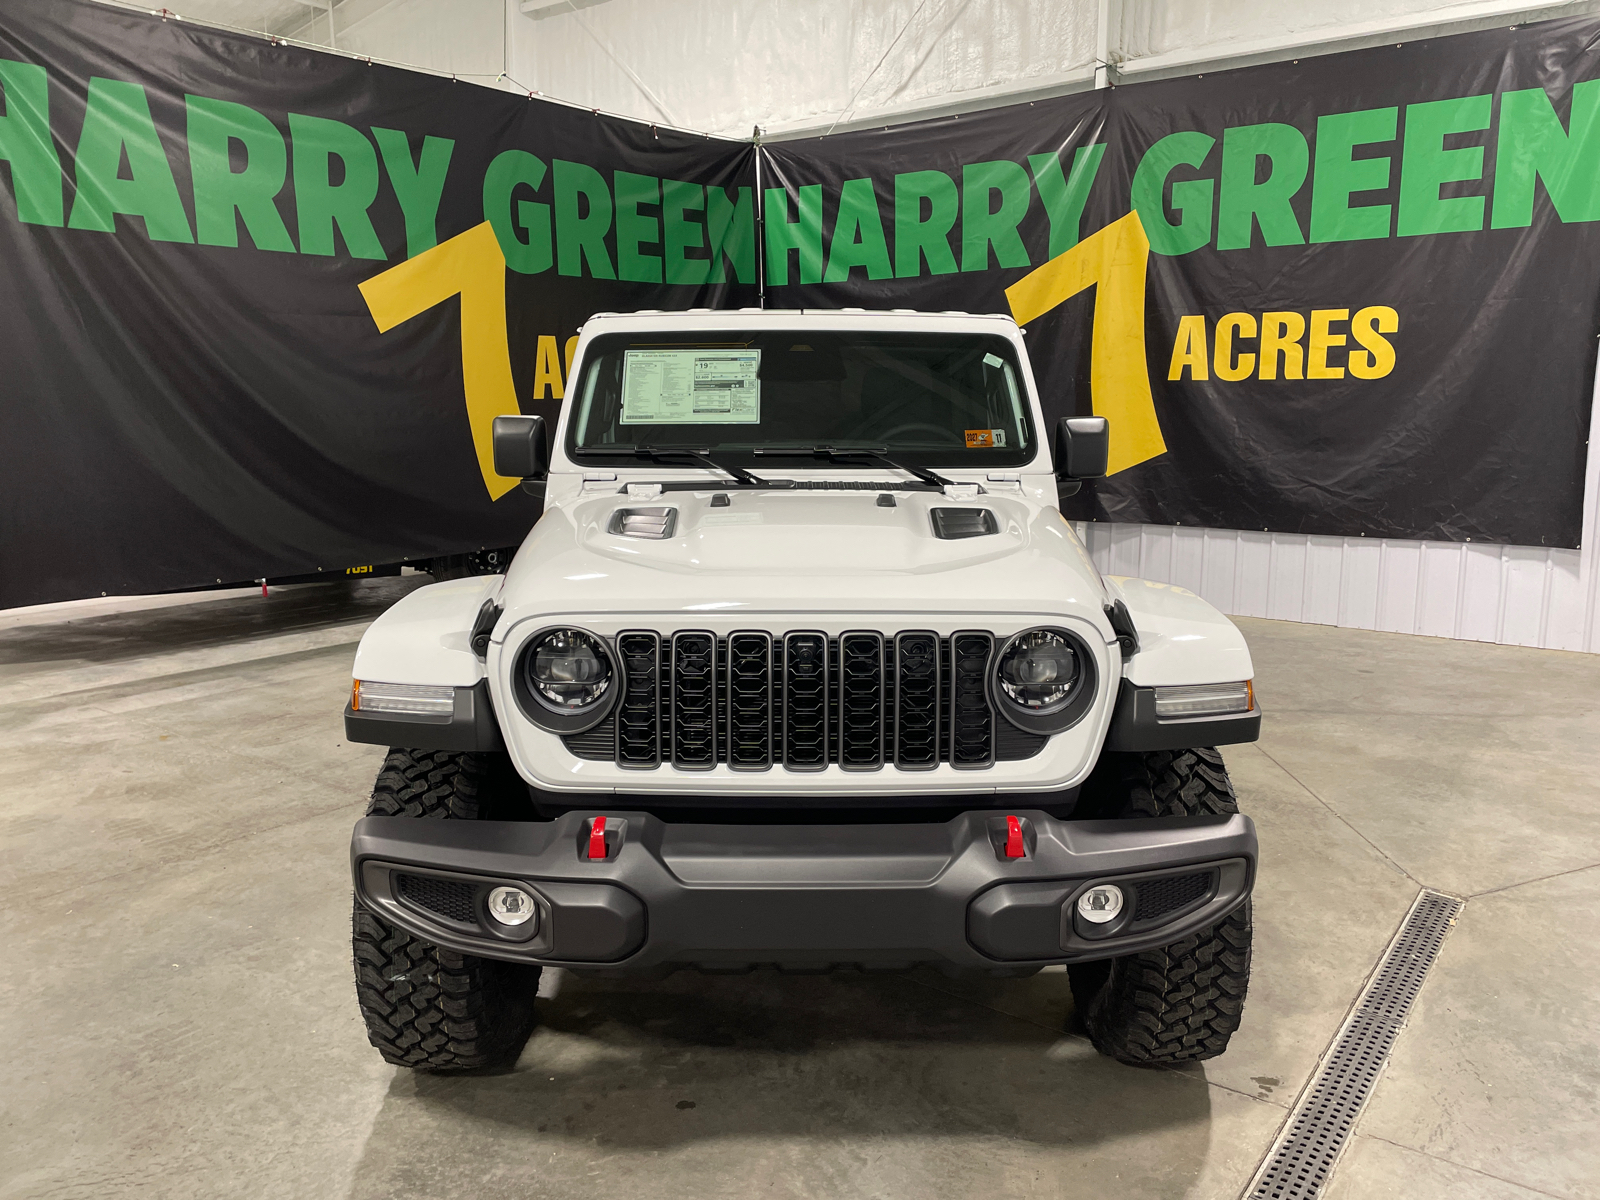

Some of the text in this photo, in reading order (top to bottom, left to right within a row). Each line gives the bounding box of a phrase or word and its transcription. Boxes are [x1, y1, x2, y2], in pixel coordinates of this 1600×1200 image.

[0, 58, 756, 285] HARRY GREEN
[764, 78, 1600, 287] HARRY GREEN
[357, 220, 522, 501] 7
[1005, 210, 1167, 478] 7
[1168, 306, 1399, 382] ACRES
